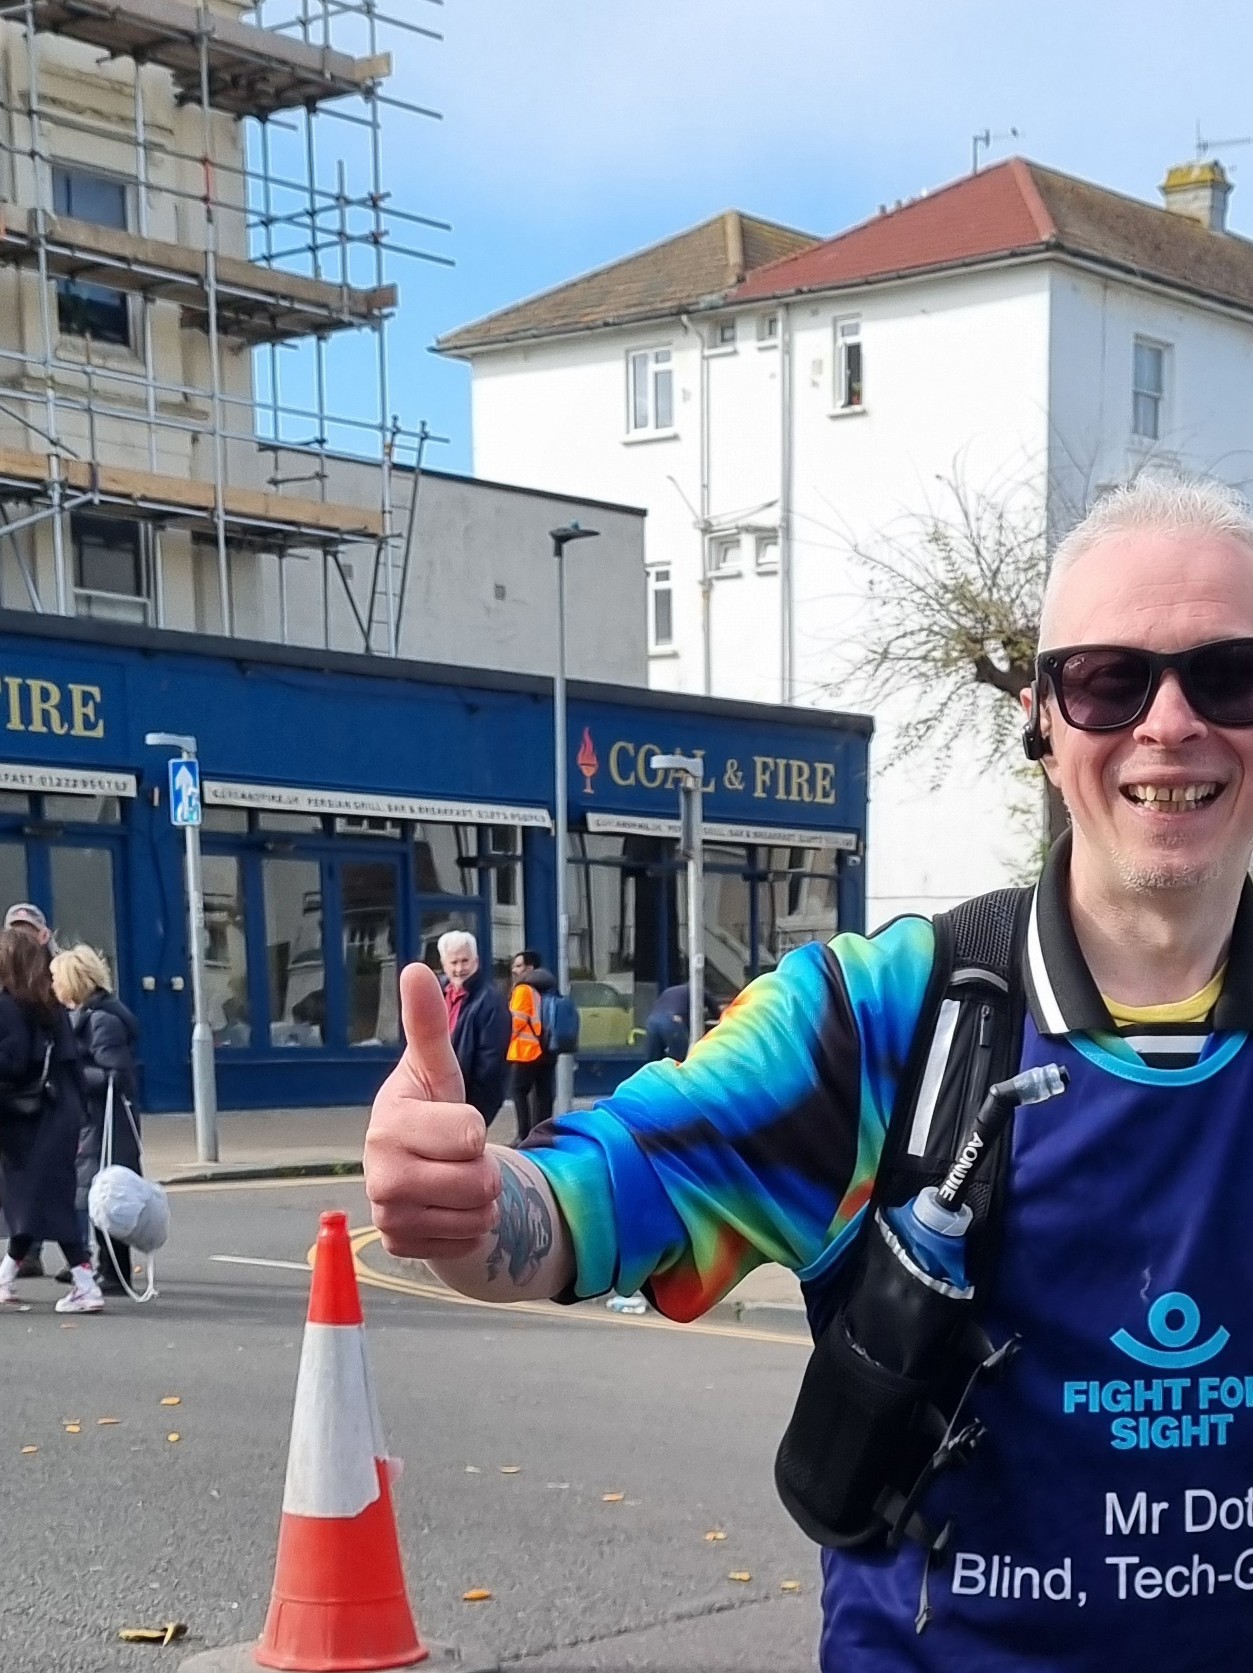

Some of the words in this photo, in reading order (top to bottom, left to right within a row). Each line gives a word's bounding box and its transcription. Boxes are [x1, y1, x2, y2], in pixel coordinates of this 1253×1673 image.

[0, 676, 105, 738] IRE
[722, 758, 745, 790] &
[752, 755, 836, 804] FIRE
[1063, 1378, 1191, 1413] FIGHT
[1110, 1414, 1234, 1450] SIGHT
[1105, 1491, 1170, 1535] Mr
[951, 1552, 1087, 1608] Blind,
